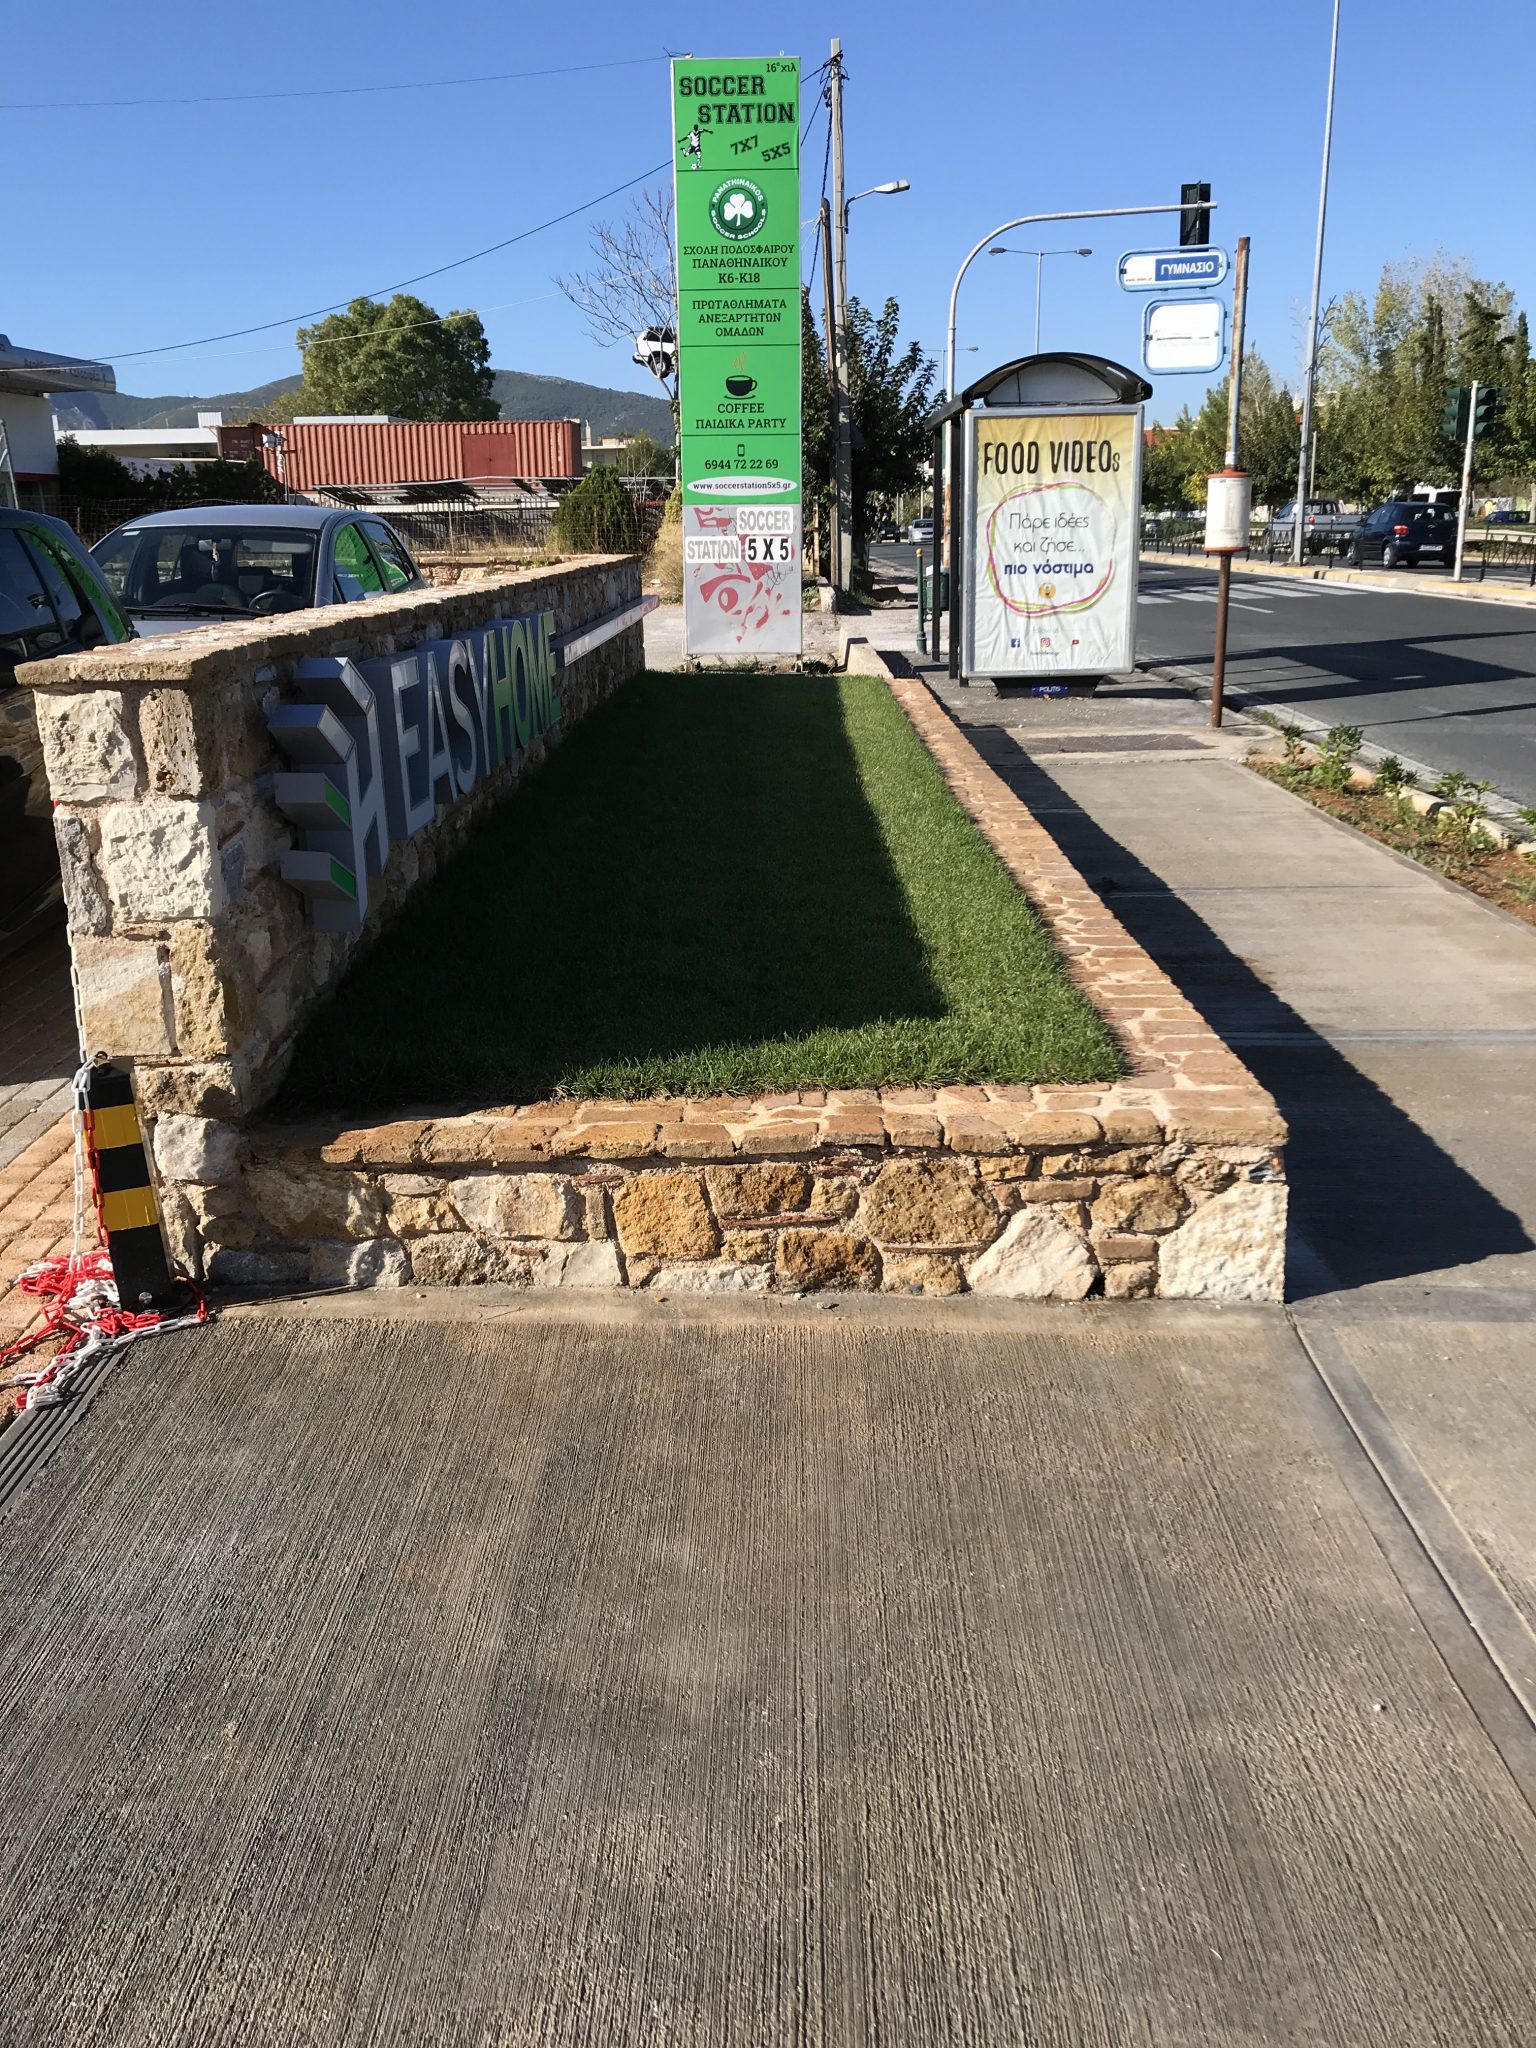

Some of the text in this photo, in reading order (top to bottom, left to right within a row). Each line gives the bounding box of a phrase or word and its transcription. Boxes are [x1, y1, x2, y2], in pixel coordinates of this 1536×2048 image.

[679, 75, 766, 97] SOCCER
[698, 102, 796, 124] STATION
[730, 135, 759, 155] 7X7
[761, 142, 791, 162] 5X5
[712, 178, 764, 203] PANATHINAIKOS
[711, 208, 766, 240] SOCCER SCHOOLS
[683, 244, 795, 255] ΣΧΟΛΗ ΠΟΔΟΣΦΑΙΡΟΥ
[692, 257, 788, 268] ΠΑΝΑΘΗΝΑΙΚΟΥ
[1161, 261, 1214, 275] ΓΥΜΝΑΣΙΟ
[692, 299, 787, 310] ΠΡΩΤΑΘΛΗΜΑΤΑ
[698, 313, 782, 323] ΑΝΕΞΑΡΤΗΤΩΝ
[715, 327, 765, 337] ΟΜΑΔΩΝ
[717, 403, 765, 414] COFFEE
[695, 418, 787, 429] ΠΑΙΔΙΚΑ PARTY
[704, 459, 779, 470] 6944 72 22 69
[983, 441, 1040, 475] FOOD
[693, 482, 792, 491] www.soccerstation5x5.gr
[739, 510, 791, 531] SOCCER
[1009, 512, 1089, 533] Πάρε ιδέες
[687, 539, 739, 560] STATION
[1013, 541, 1036, 553] και
[1004, 558, 1094, 578] πιο νόστιμα
